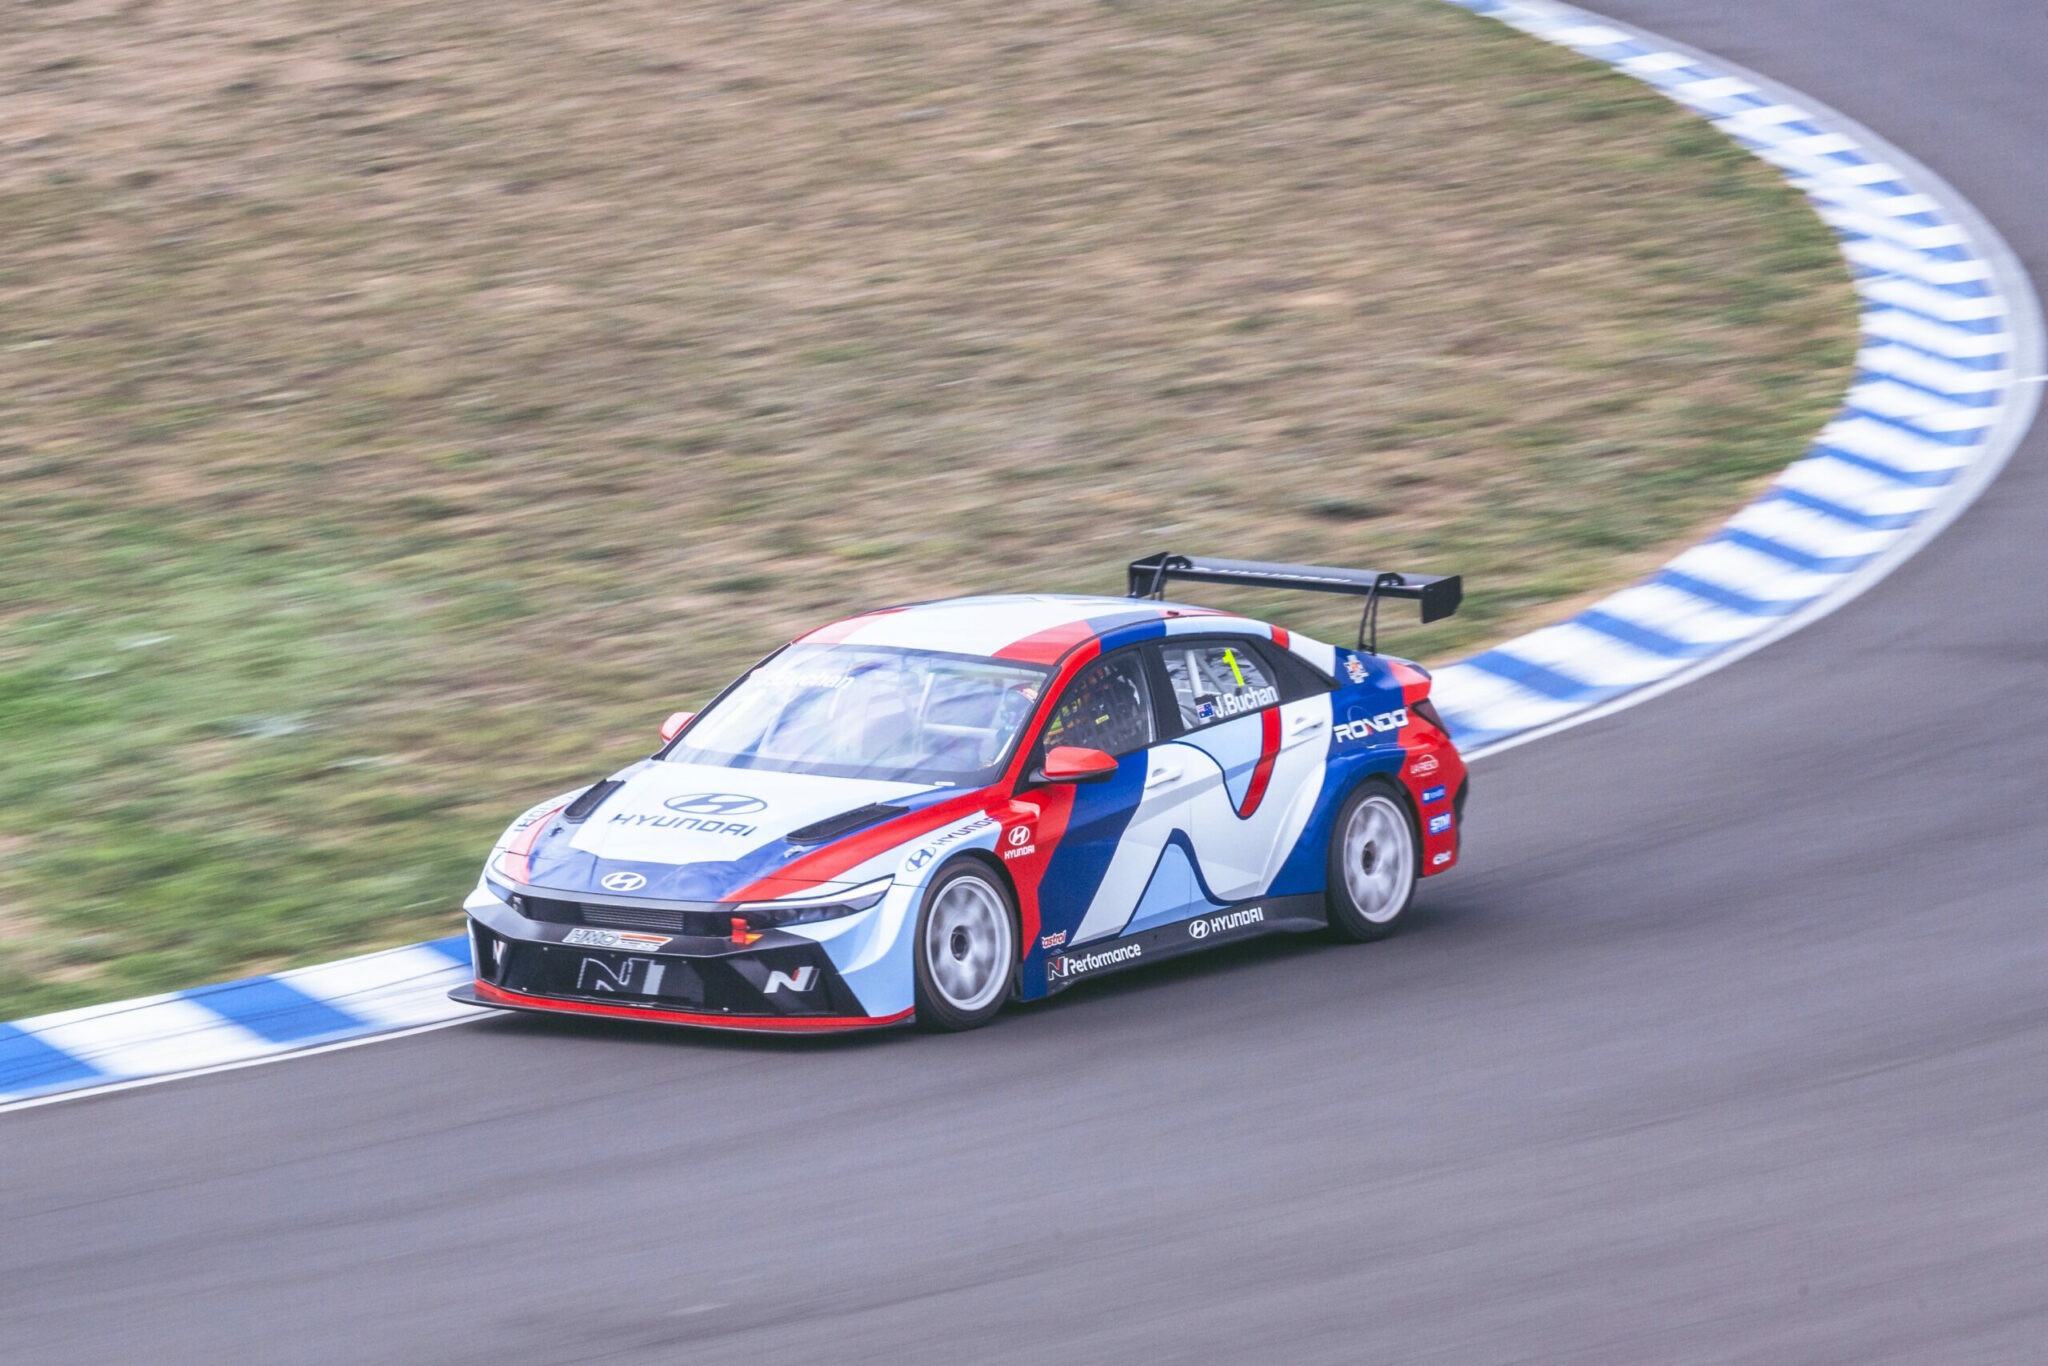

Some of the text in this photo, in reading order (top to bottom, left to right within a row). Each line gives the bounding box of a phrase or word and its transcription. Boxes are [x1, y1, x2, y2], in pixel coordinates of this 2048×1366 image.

[1222, 648, 1245, 687] 1
[1214, 685, 1279, 718] J.Buchan
[1333, 708, 1409, 743] RONDO
[608, 813, 757, 836] HYUNDAI
[1004, 844, 1035, 860] HYUNDAI
[1211, 906, 1264, 933] HYUNDAI
[1068, 943, 1142, 975] Performance
